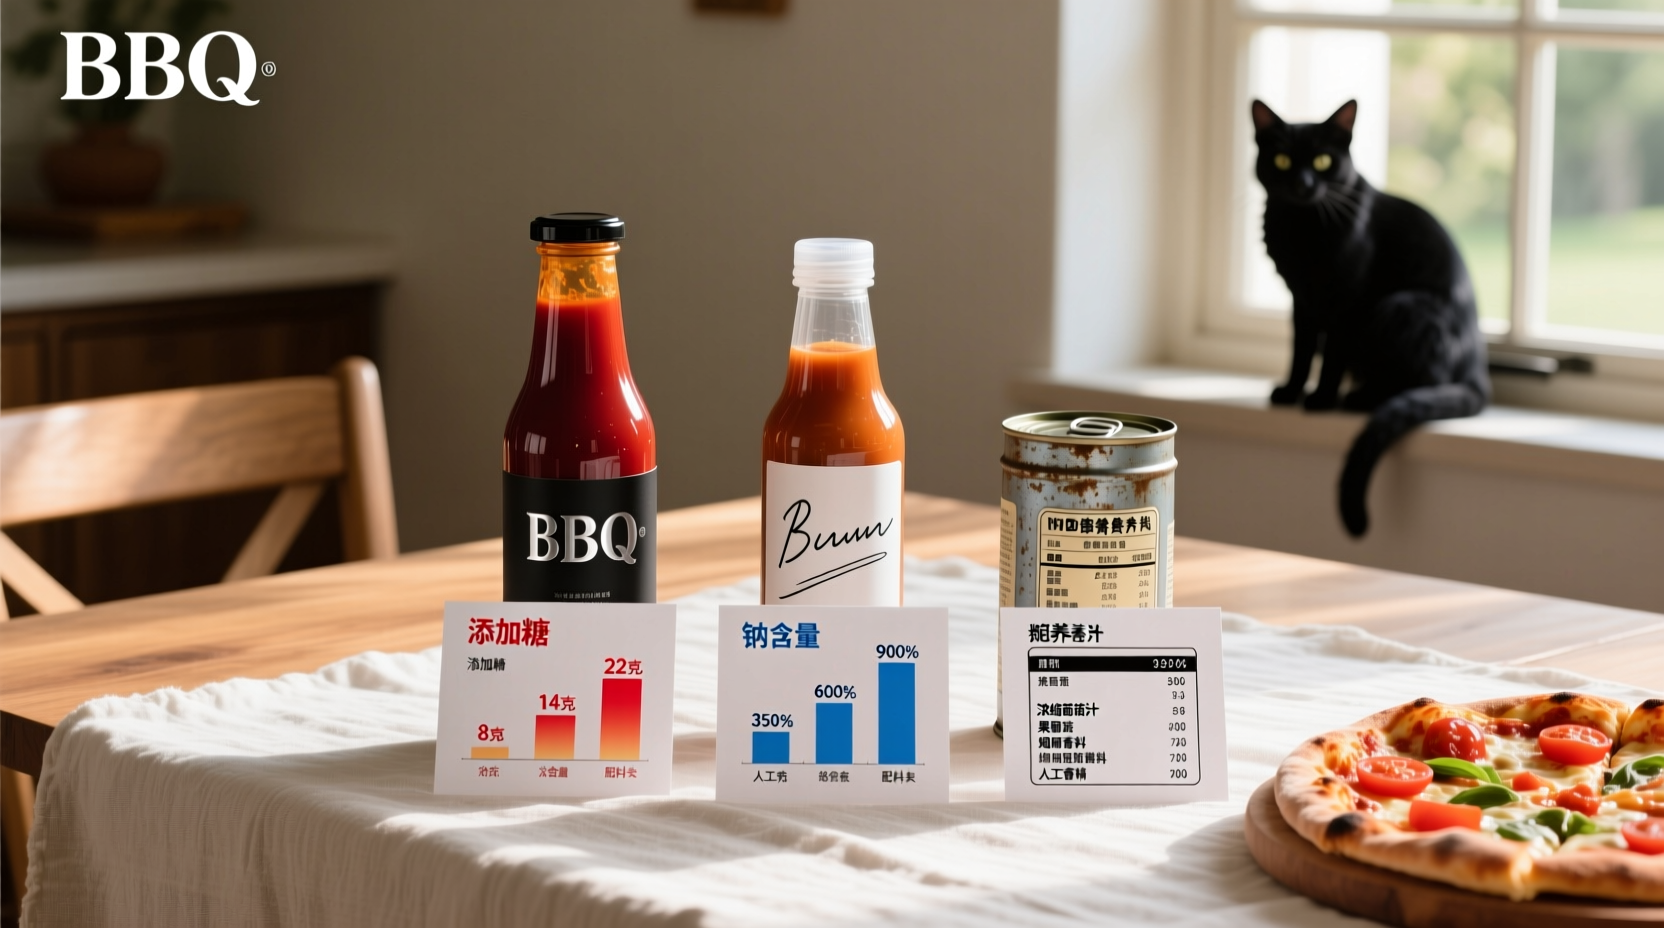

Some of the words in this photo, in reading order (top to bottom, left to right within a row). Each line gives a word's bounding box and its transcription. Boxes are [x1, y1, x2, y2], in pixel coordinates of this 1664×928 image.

[526, 511, 638, 565] BBQ
[468, 617, 550, 647] 添加糖
[742, 621, 820, 649] 钠含量
[876, 644, 919, 659] 900%
[604, 657, 643, 675] 22克
[814, 684, 857, 699] 600%
[539, 693, 576, 711] 14克
[751, 713, 793, 728] 350%
[477, 724, 505, 742] 8克
